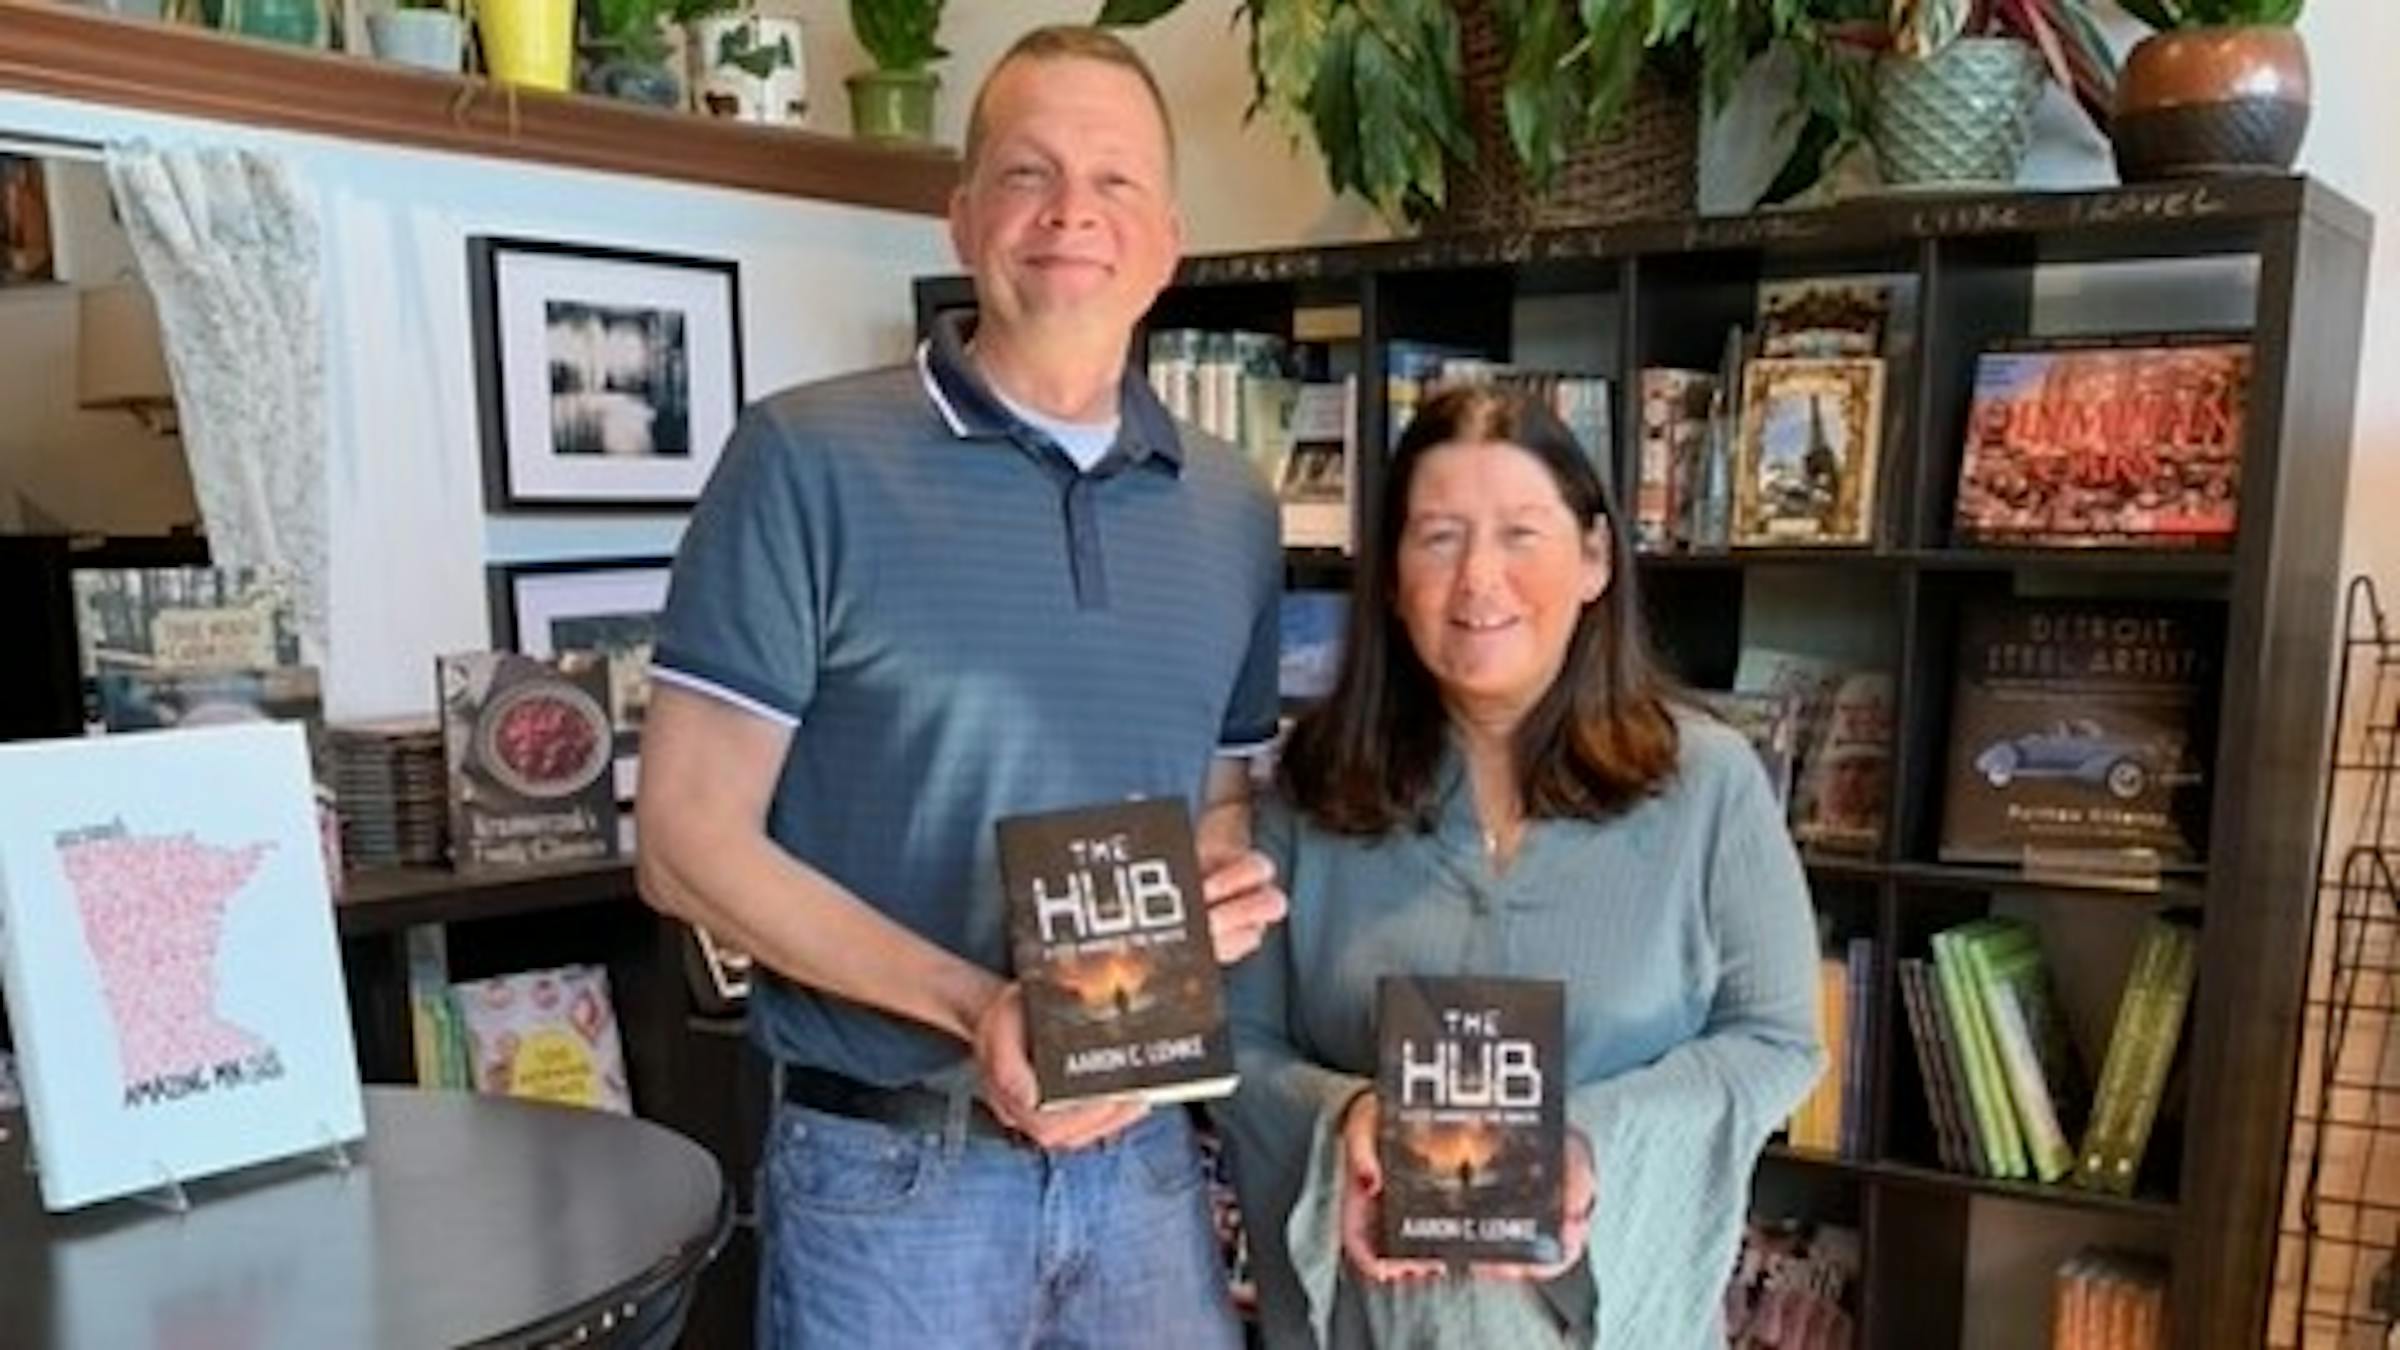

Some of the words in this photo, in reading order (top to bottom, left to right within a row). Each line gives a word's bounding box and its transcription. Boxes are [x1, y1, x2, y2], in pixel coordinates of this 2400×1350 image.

[2028, 613, 2174, 643] DETROIT
[1067, 834, 1129, 868] THE
[1032, 857, 1187, 942] HUB
[1443, 1007, 1501, 1037] THE
[1063, 1047, 1127, 1077] AARON
[1402, 1038, 1544, 1107] HUB
[1400, 1216, 1462, 1240] AARON
